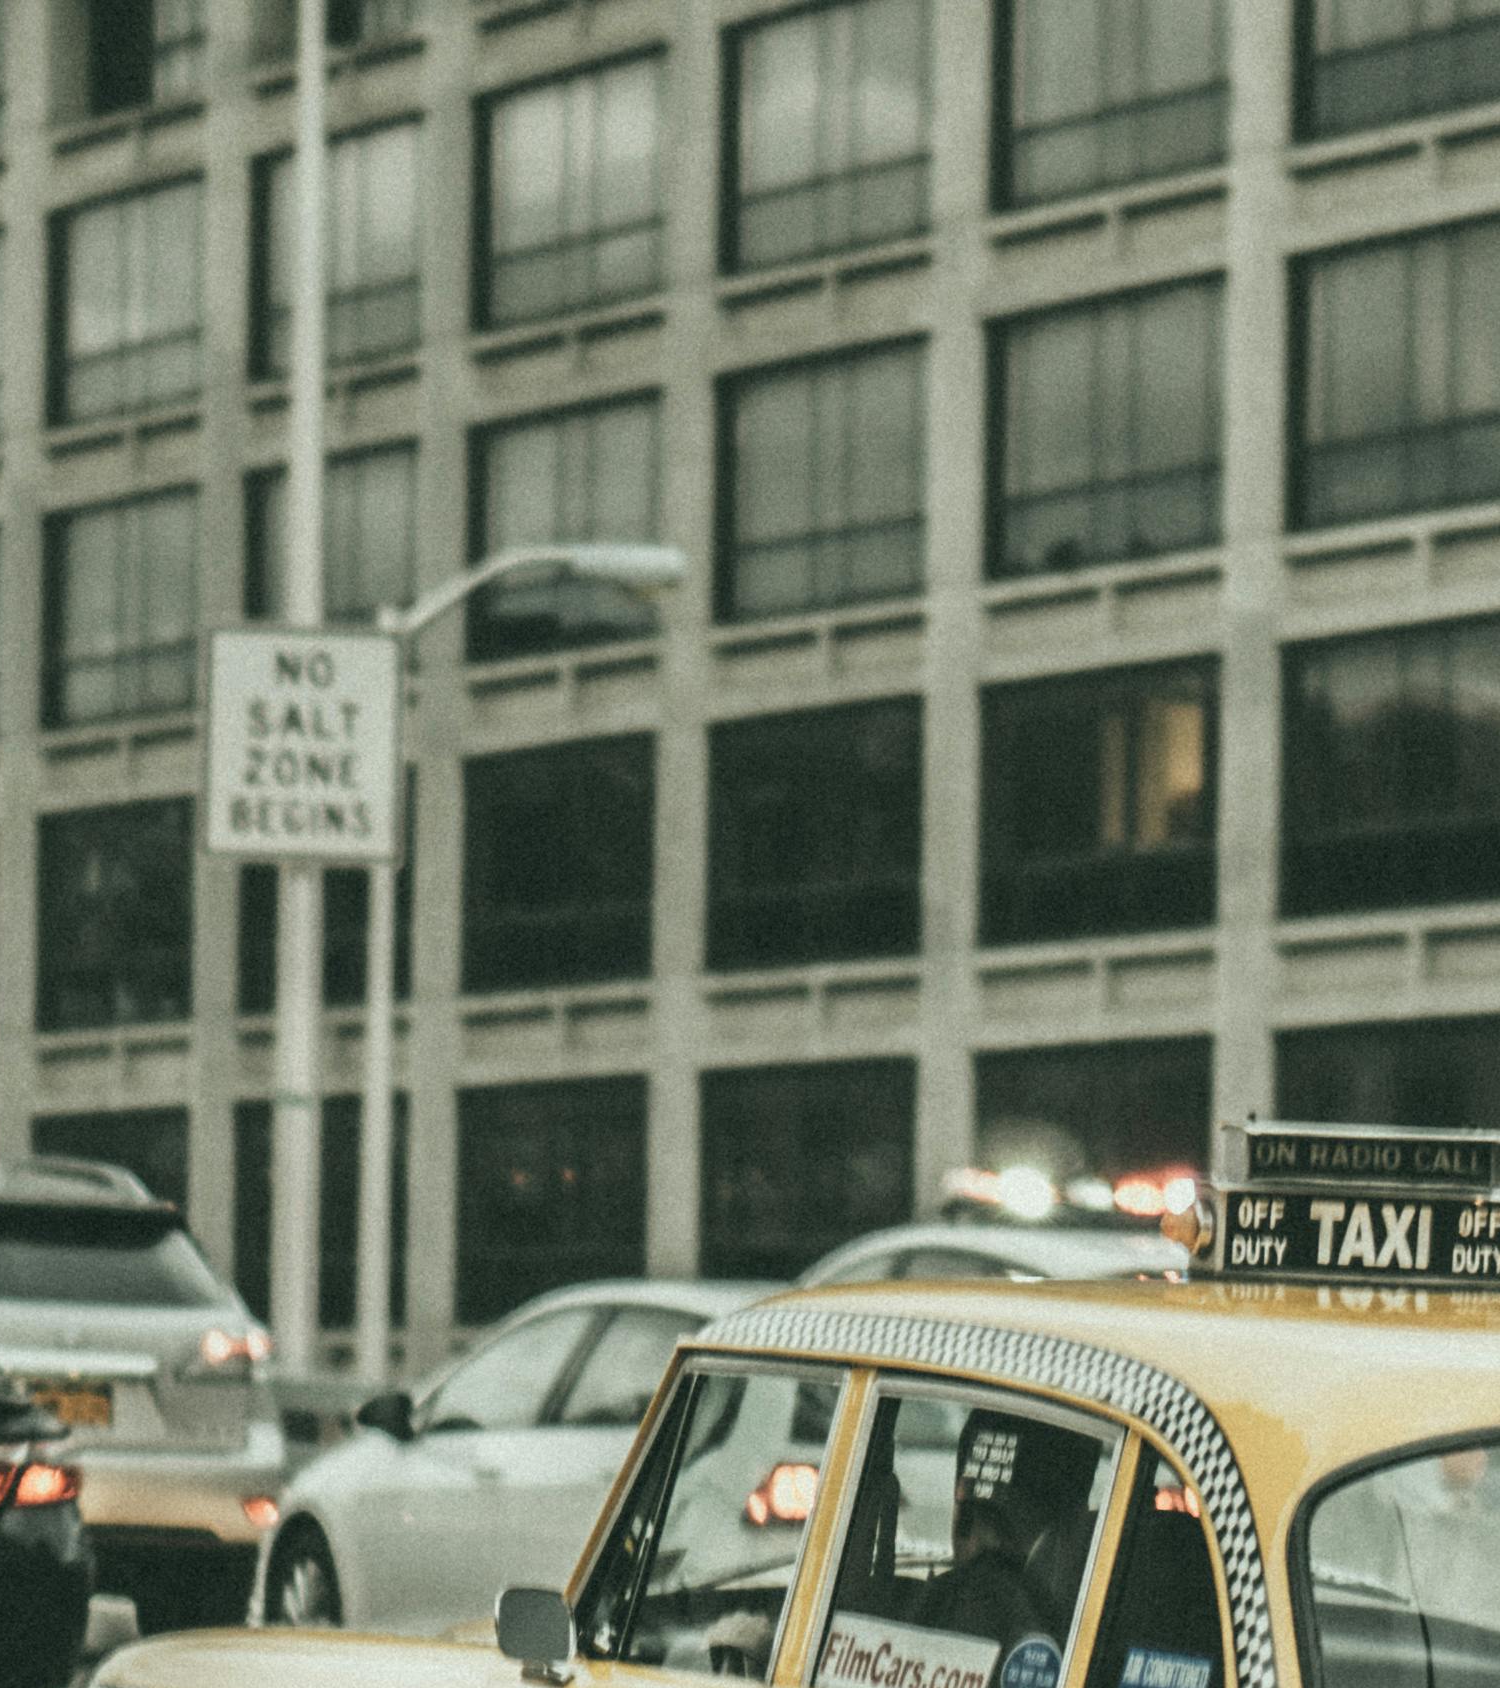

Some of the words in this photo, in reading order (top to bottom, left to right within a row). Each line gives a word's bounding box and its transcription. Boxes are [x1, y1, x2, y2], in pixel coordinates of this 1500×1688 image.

[275, 651, 335, 689] NO
[250, 701, 358, 740] SALT
[245, 748, 355, 789] ZONE
[230, 799, 371, 839] BEGINS
[1255, 1141, 1297, 1168] ON
[1309, 1143, 1401, 1171] RADIO
[1238, 1197, 1285, 1230] OFF
[1231, 1234, 1288, 1266] DUTY
[1309, 1201, 1433, 1270] TAXI
